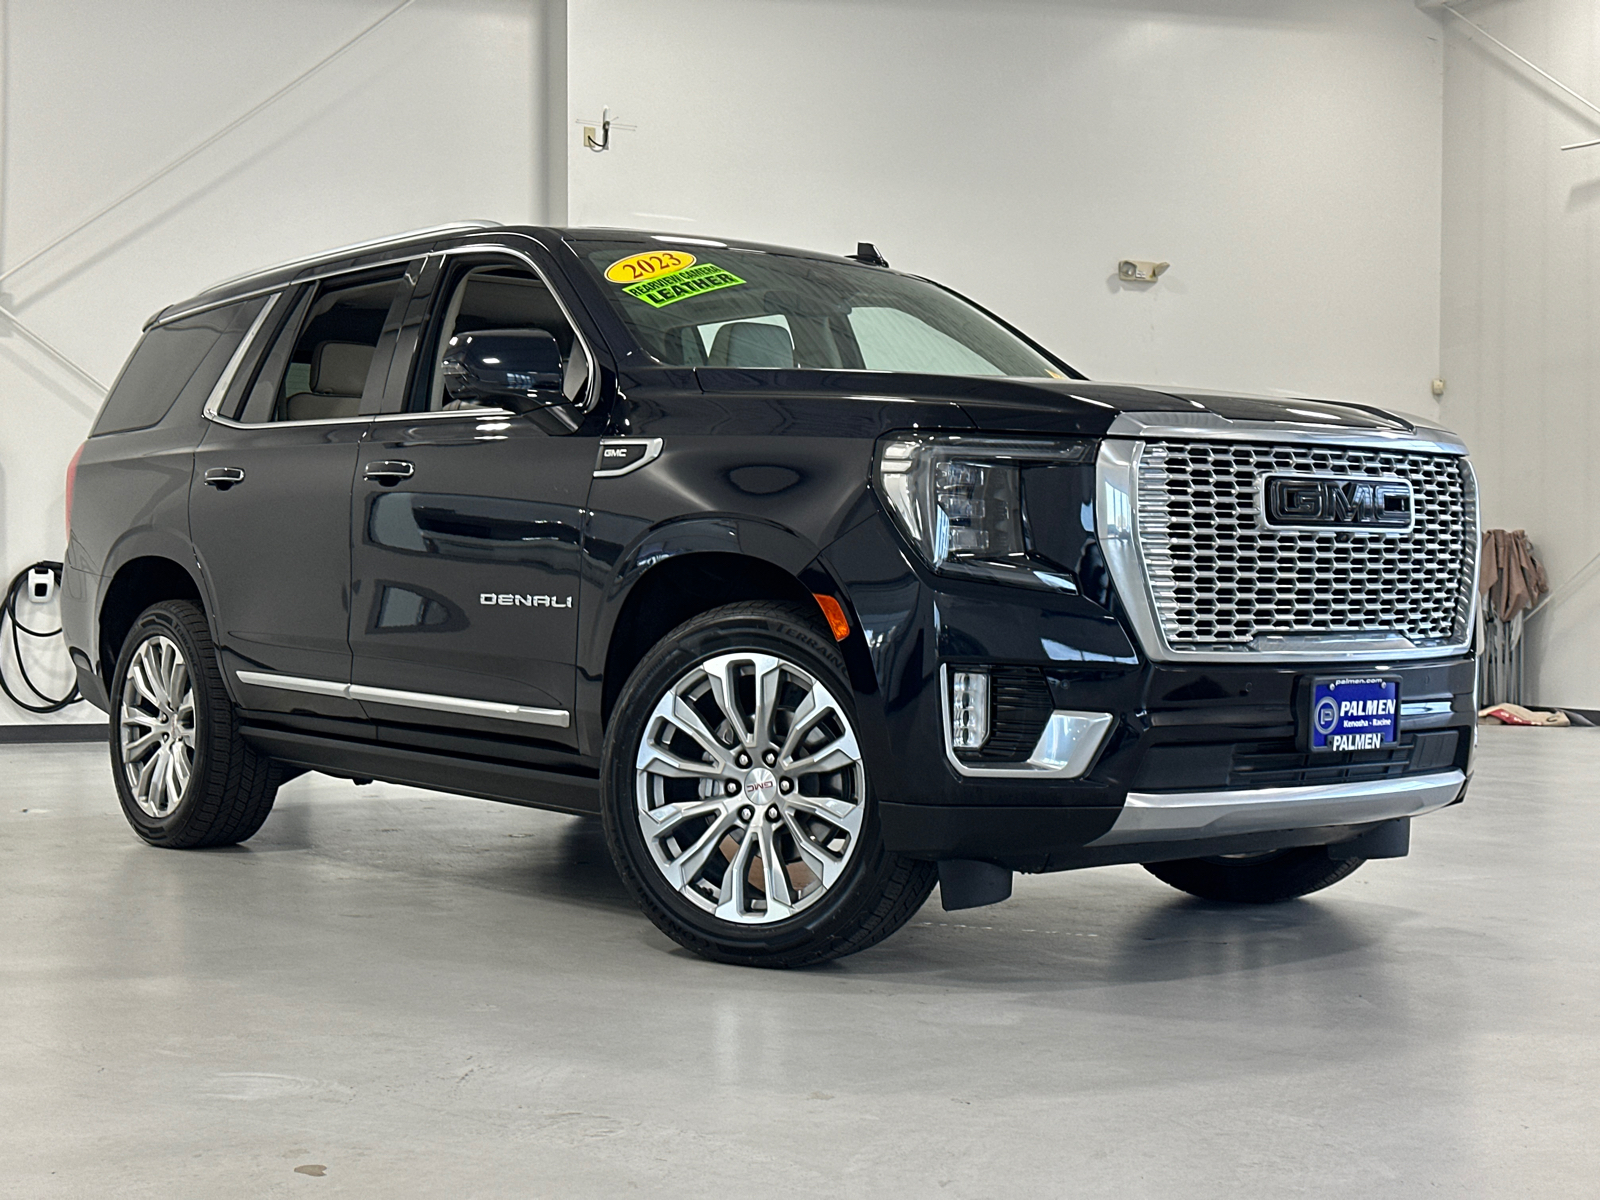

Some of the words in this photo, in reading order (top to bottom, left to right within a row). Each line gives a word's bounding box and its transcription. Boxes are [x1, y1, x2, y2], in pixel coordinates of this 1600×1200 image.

[622, 252, 682, 279] 2023
[629, 271, 681, 297] REARVIEW
[679, 264, 722, 280] CAMERA
[645, 272, 738, 304] LEATHER
[604, 448, 627, 457] GMC
[1270, 480, 1411, 523] GMC
[480, 592, 573, 609] DENALI
[1335, 678, 1383, 686] palmen.com
[1340, 698, 1397, 717] PALMEN
[1343, 720, 1369, 728] Kenosha
[1373, 718, 1391, 726] Racine
[1332, 732, 1382, 752] PALMEN
[746, 780, 774, 793] GMC
